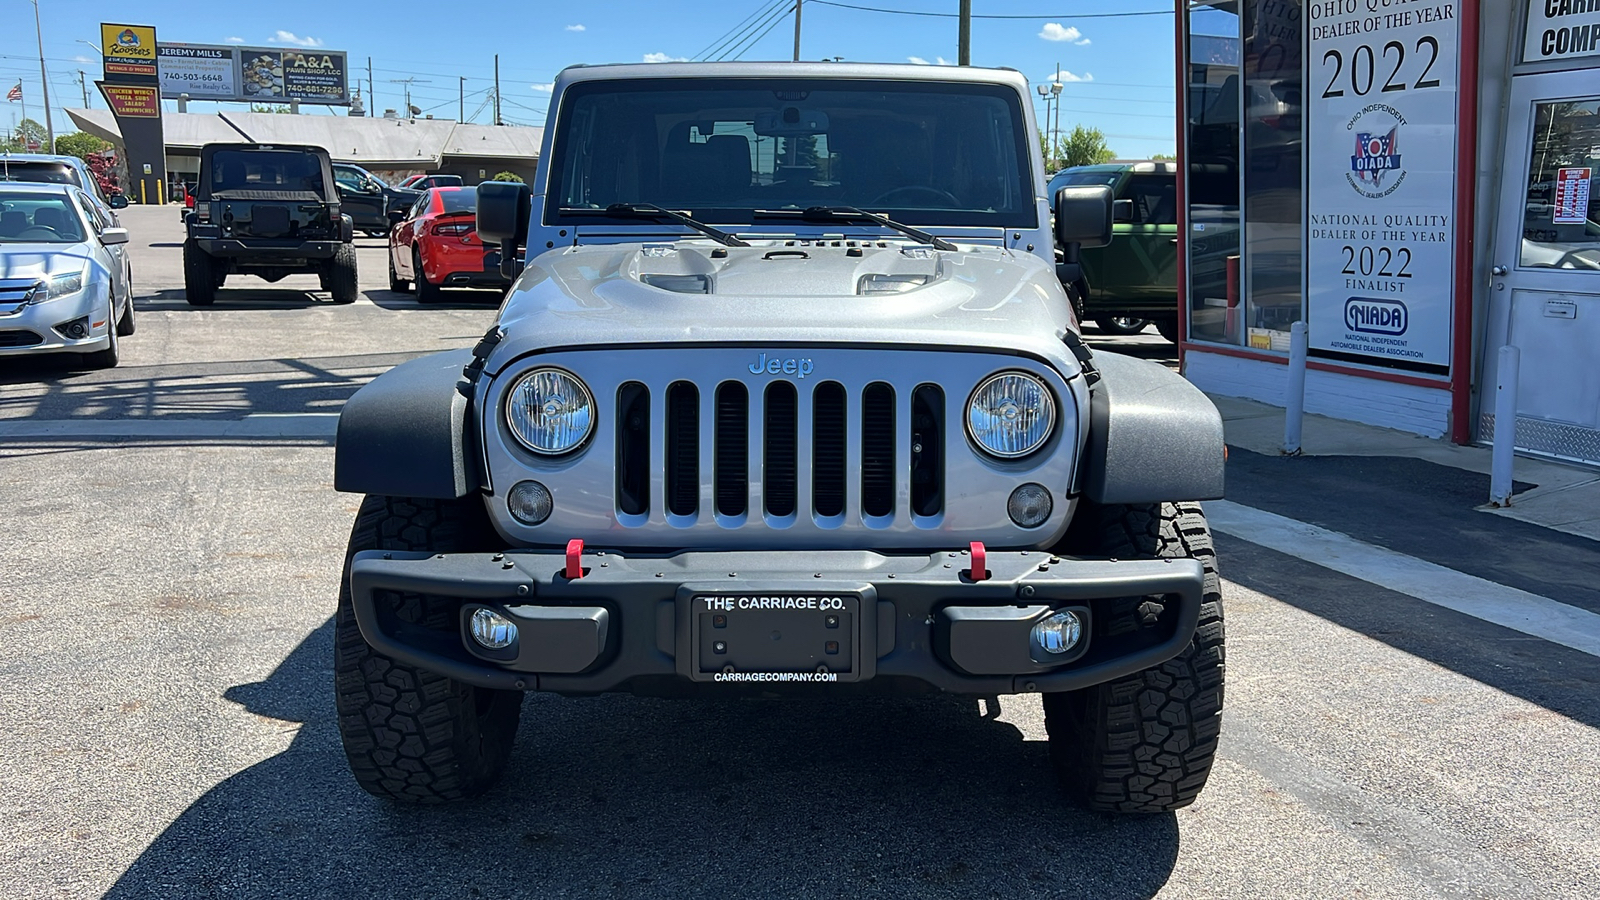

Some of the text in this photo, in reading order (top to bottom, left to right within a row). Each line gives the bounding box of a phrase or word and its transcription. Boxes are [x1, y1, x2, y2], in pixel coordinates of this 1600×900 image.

[1311, 0, 1357, 19] OHIO
[1312, 4, 1454, 41] DEALER OF THE YEAR
[109, 43, 151, 56] Roosters
[161, 48, 222, 57] JEREMY MILLS
[294, 54, 334, 69] A&A
[1321, 35, 1440, 99] 2022
[164, 72, 223, 81] 740-503-6648
[203, 83, 220, 91] Realty
[1346, 103, 1407, 130] OHIO INDEPENDENT
[1356, 156, 1392, 169] OIADA
[1365, 191, 1384, 199] DEALERS
[1311, 214, 1448, 228] NATIONAL QUALITY
[1312, 229, 1446, 242] DEALER OF THE YEAR
[1341, 245, 1412, 278] 2022
[1345, 279, 1405, 292] FINALIST
[1350, 304, 1401, 327] NIADA
[1345, 333, 1408, 347] NATIONAL INDEPENDENT
[1331, 341, 1424, 358] AUTOMOBILE DEALERS ASSOCIATION
[748, 352, 814, 379] Jeep
[705, 597, 846, 610] THE CARRIAGE CO.
[714, 672, 837, 682] CARRIAGECOMPANY.COM
